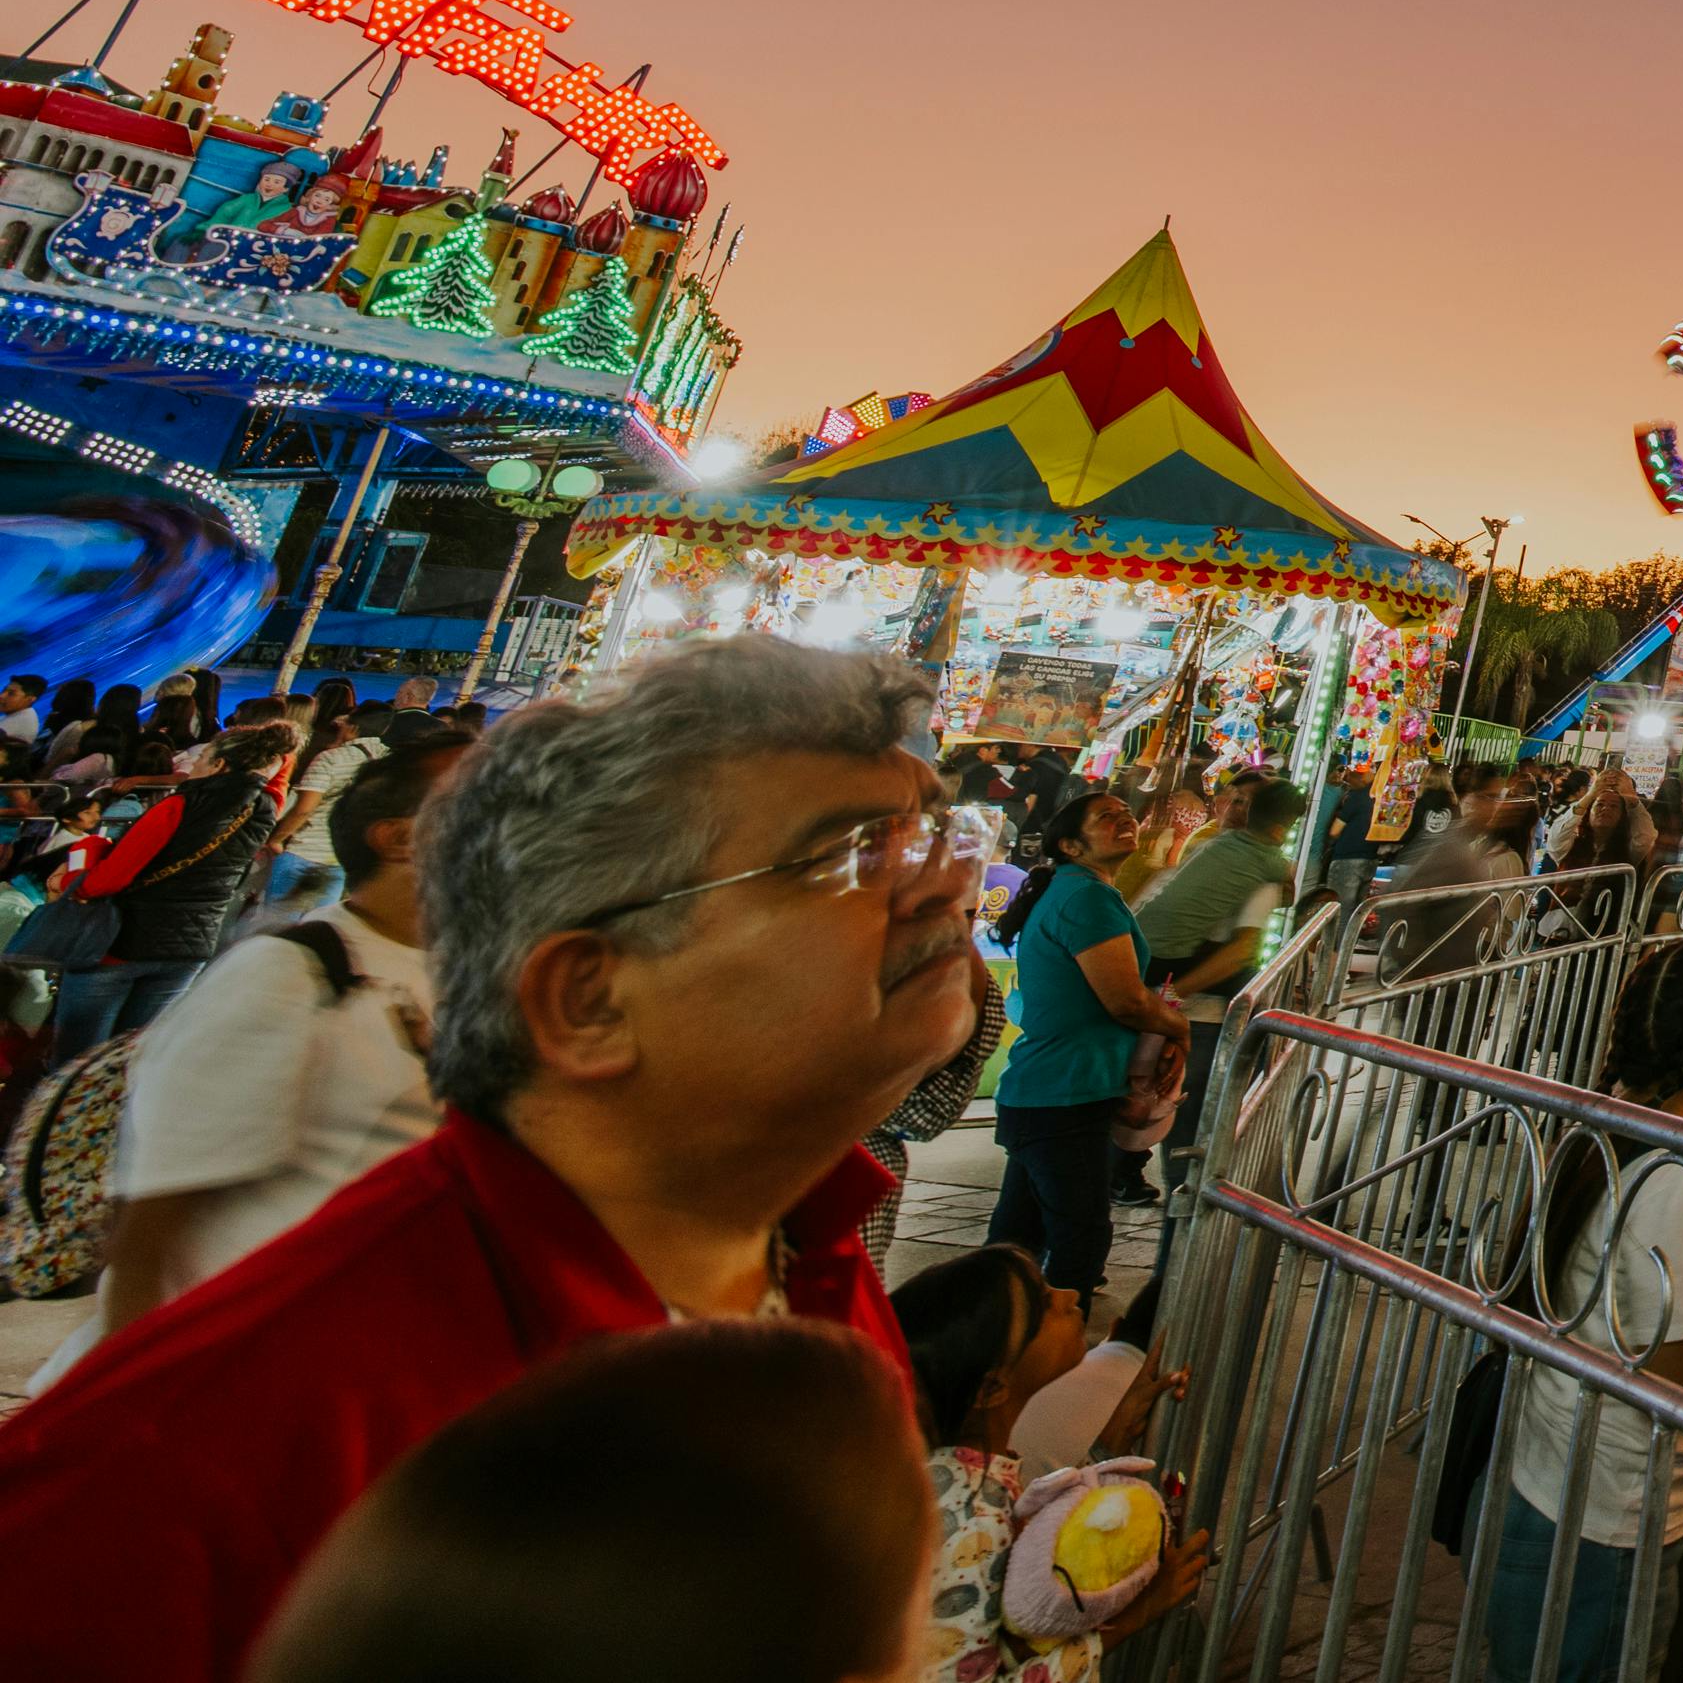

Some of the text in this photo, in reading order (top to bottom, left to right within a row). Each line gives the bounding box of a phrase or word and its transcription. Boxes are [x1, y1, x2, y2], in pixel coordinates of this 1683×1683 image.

[1019, 663, 1036, 672] LAS
[1067, 660, 1091, 669] TODAS
[1047, 674, 1076, 683] PREMIO
